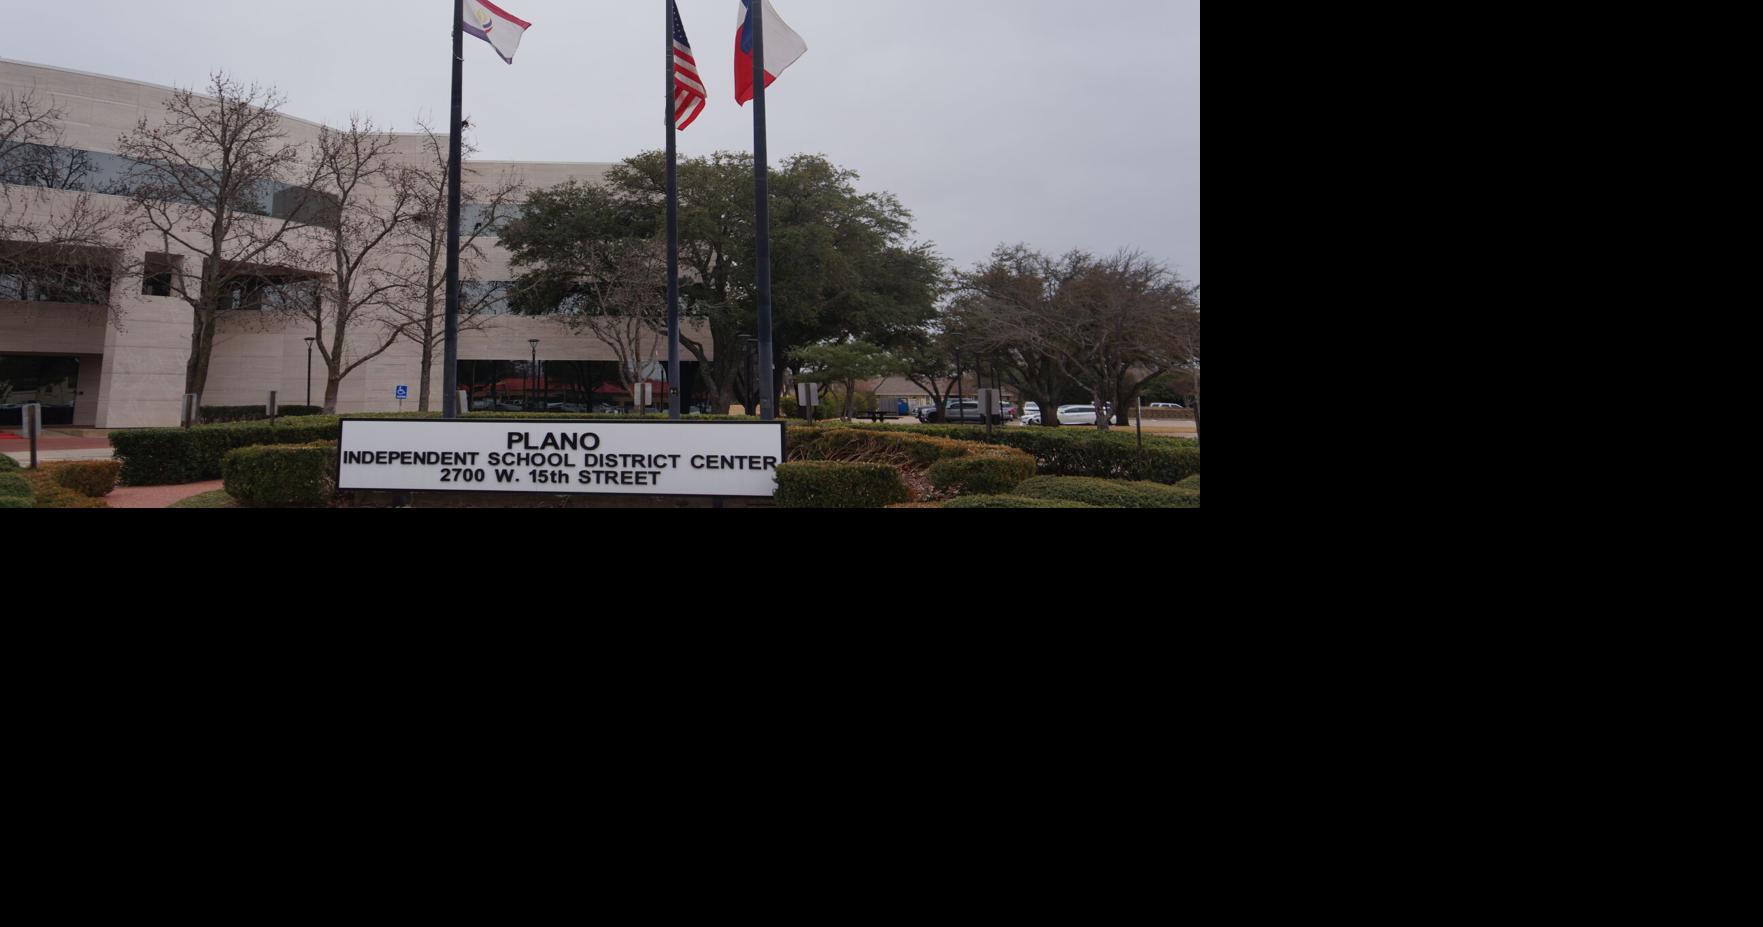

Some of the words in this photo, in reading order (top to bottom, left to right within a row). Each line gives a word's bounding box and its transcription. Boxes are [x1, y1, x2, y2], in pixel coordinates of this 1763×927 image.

[507, 432, 600, 451] PLANO
[343, 450, 479, 466] INDEPENDENT
[488, 452, 576, 468] SCHOOL
[584, 453, 681, 469] DISTRICT
[690, 455, 777, 470] CENTER
[440, 468, 485, 482] 2700
[495, 469, 519, 483] W.
[530, 469, 569, 484] 15th
[578, 470, 661, 486] STREET
